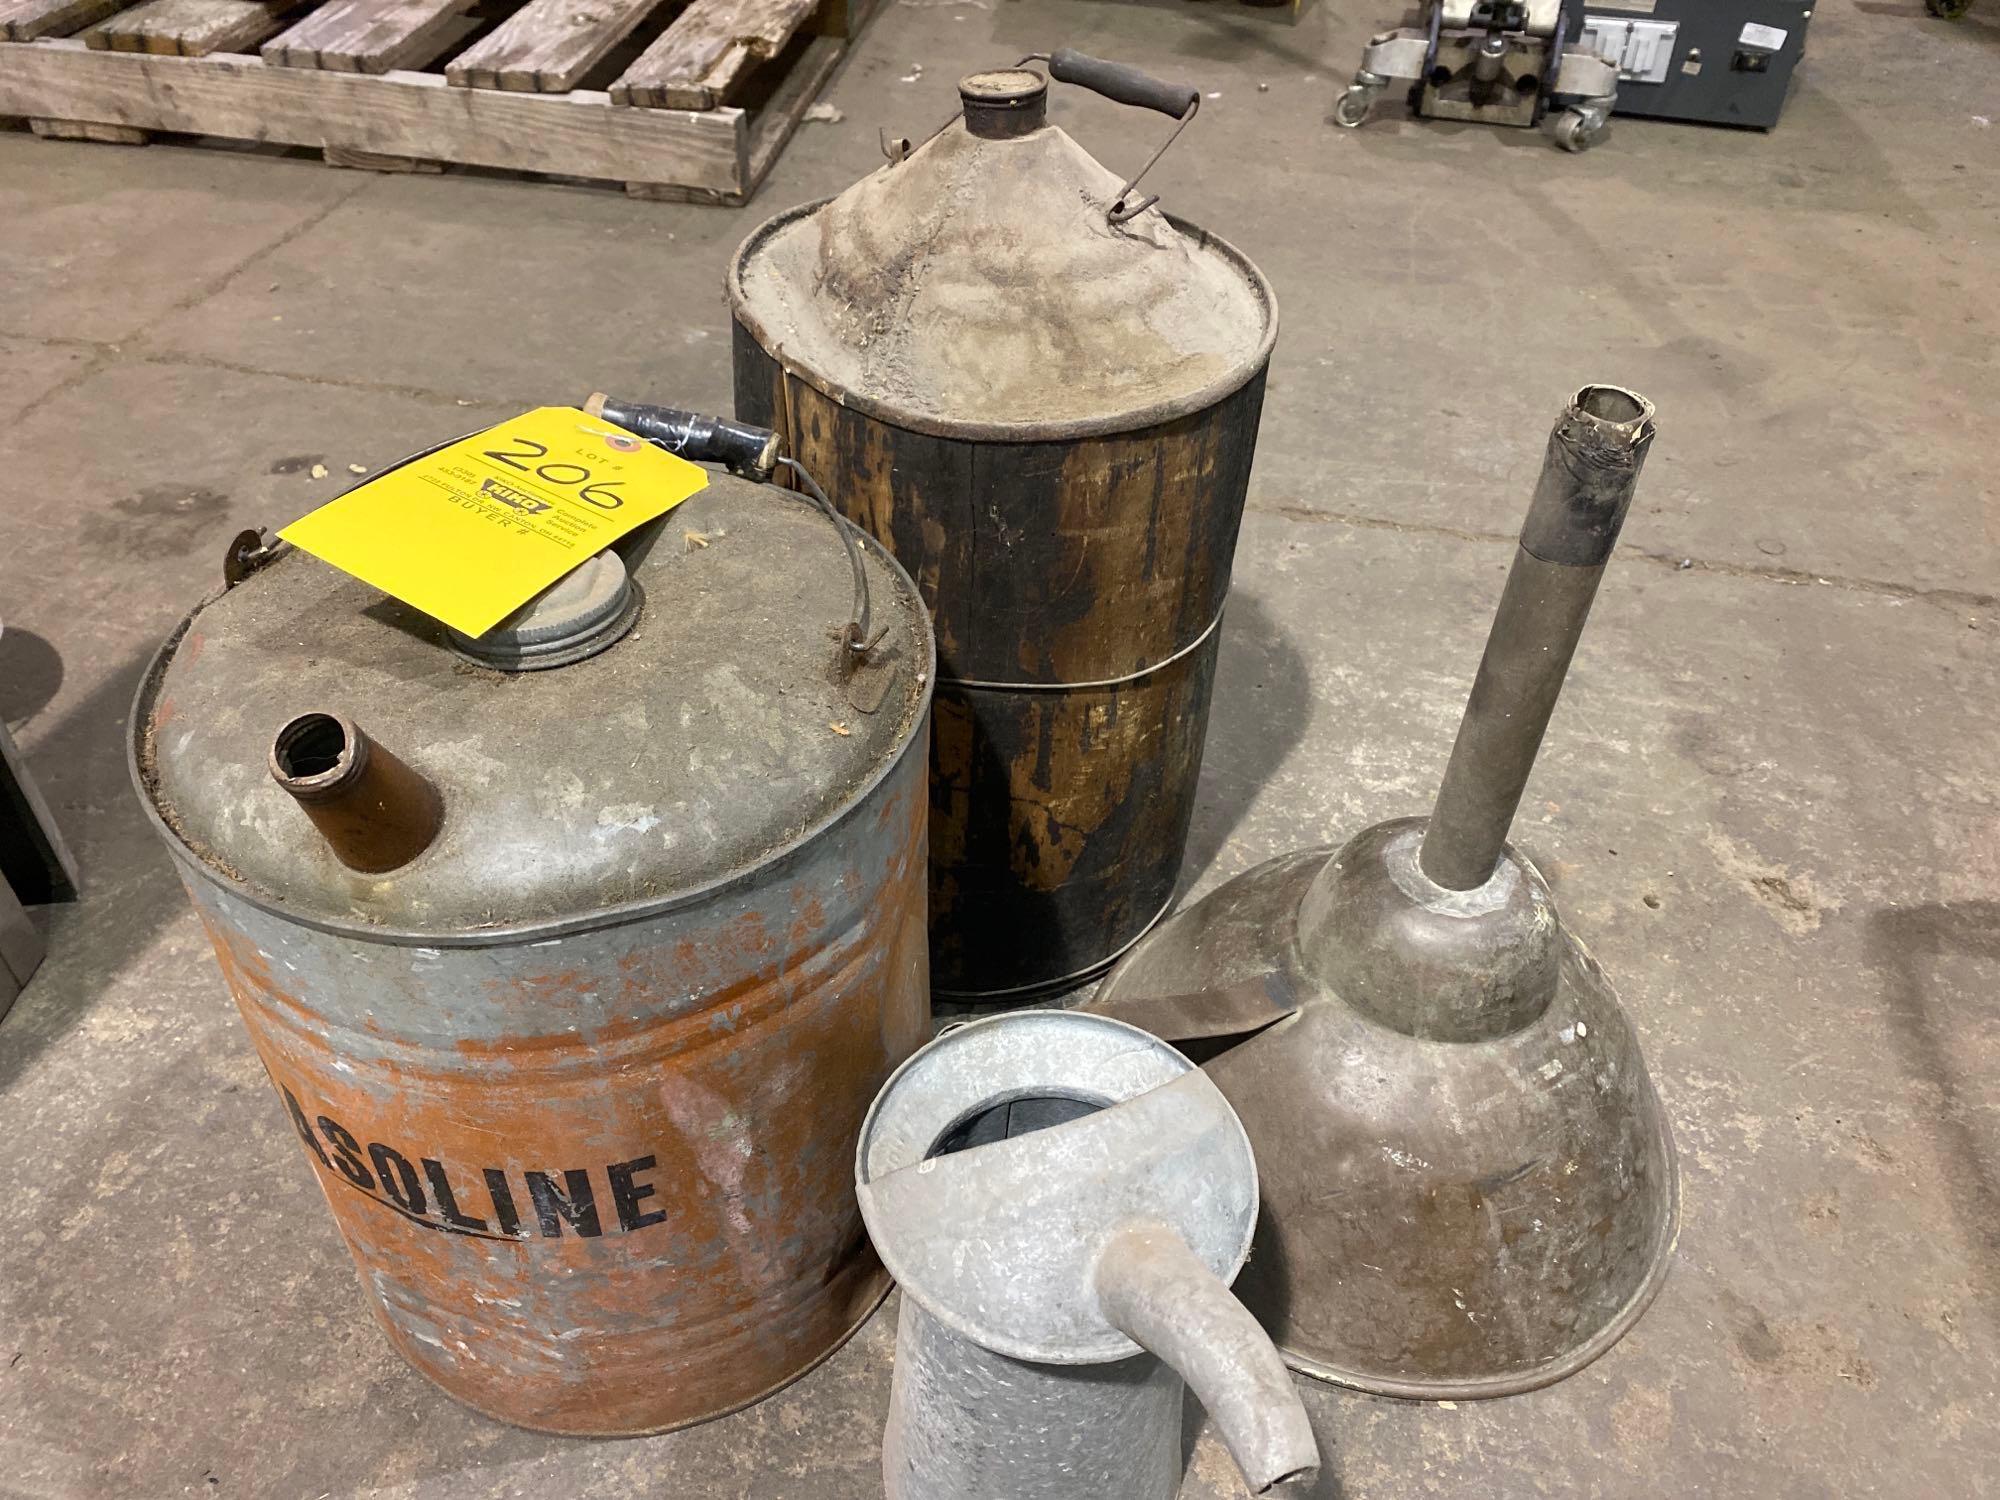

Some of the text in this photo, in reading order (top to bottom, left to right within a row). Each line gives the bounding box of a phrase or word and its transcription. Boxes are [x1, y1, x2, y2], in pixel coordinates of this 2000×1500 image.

[575, 448, 608, 463] LOT
[482, 437, 625, 509] 206
[486, 483, 540, 510] KIKO
[447, 495, 512, 528] BUYER
[556, 509, 598, 530] Complete
[545, 519, 579, 536] Service
[551, 515, 587, 533] Auction
